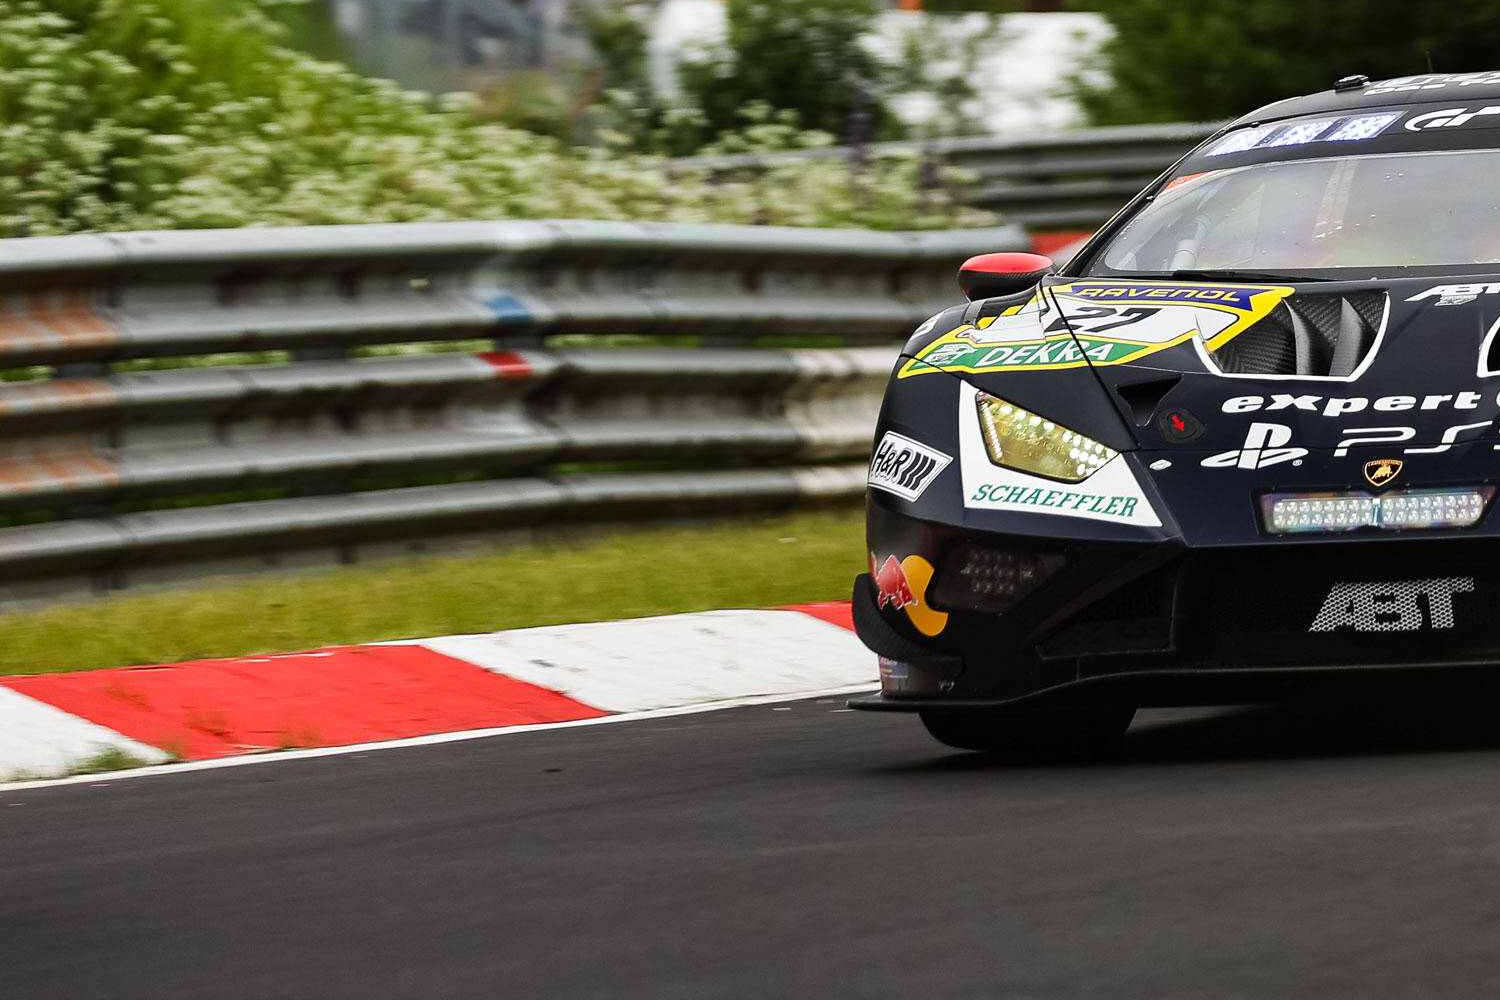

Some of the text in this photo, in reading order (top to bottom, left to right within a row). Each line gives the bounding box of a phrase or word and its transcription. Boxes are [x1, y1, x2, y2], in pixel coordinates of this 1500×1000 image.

[1078, 287, 1244, 303] RAVENOL
[1043, 306, 1161, 334] 27
[974, 342, 1114, 368] DEKRA
[1222, 391, 1482, 417] expert
[972, 484, 1138, 518] SCHAEFFLER
[1308, 577, 1475, 632] ABT
